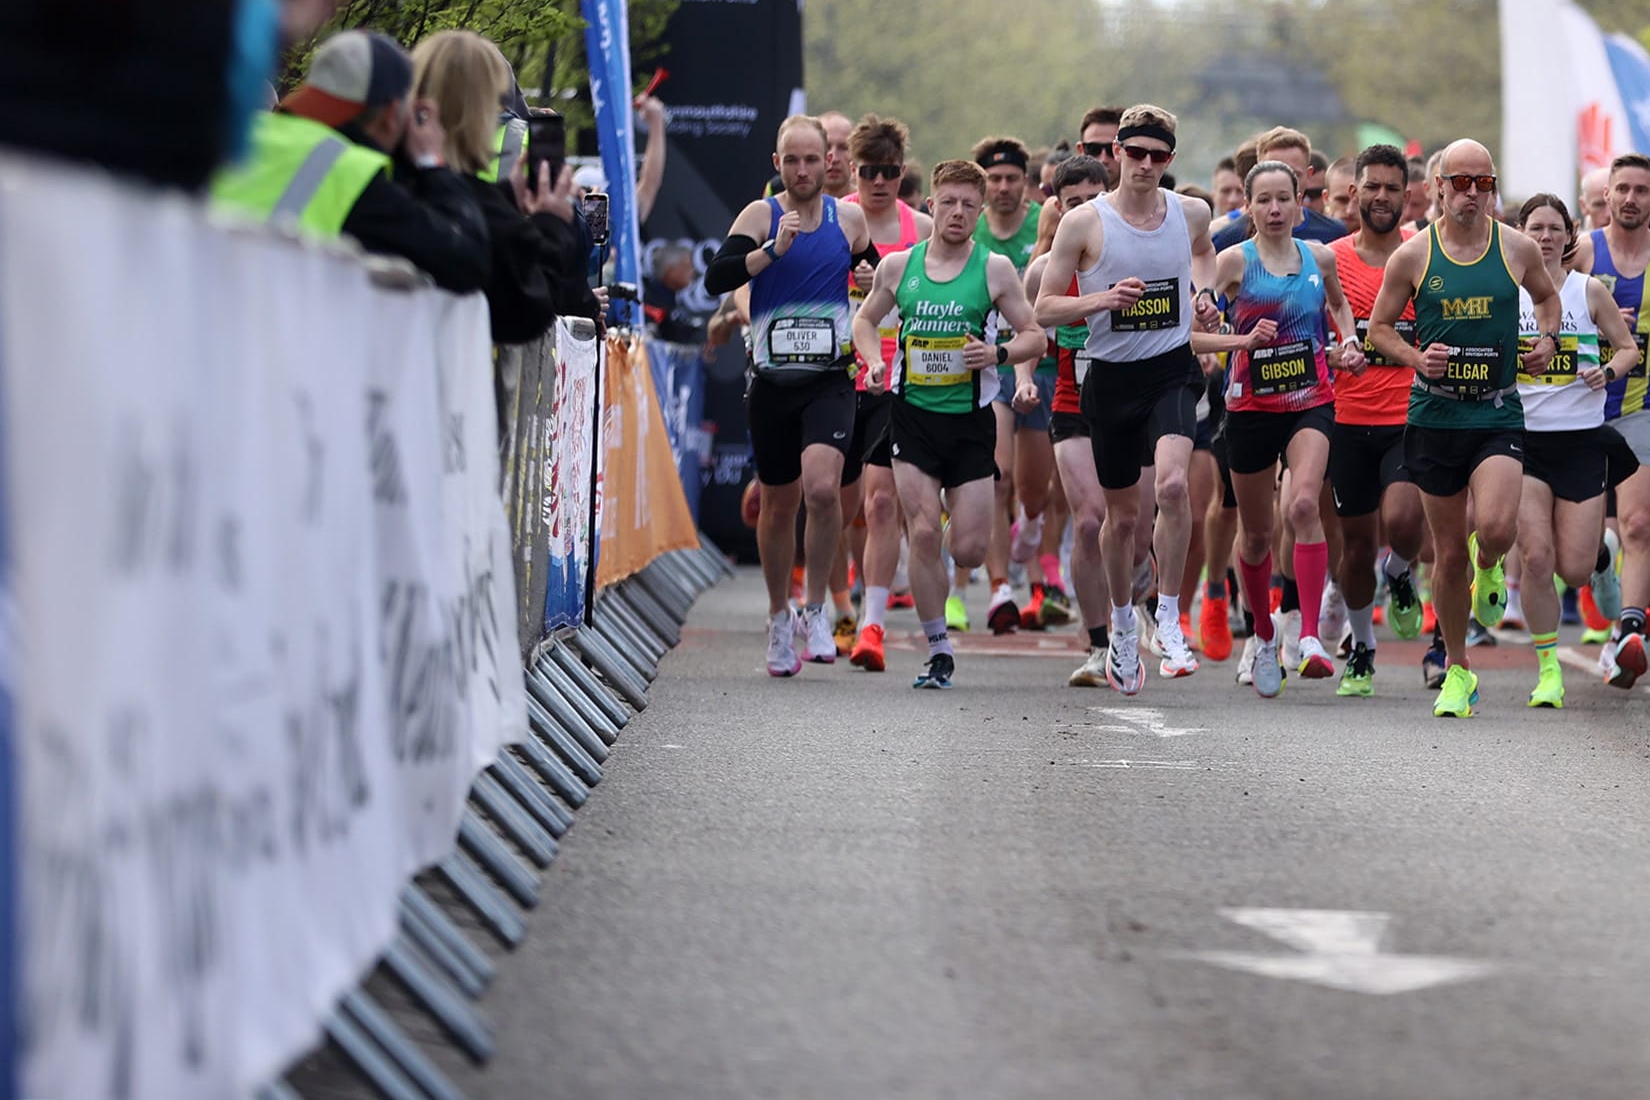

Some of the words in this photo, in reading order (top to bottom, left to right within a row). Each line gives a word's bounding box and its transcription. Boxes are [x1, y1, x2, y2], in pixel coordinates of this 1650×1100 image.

[916, 300, 964, 319] Hayle
[909, 317, 972, 332] Runners
[786, 331, 817, 340] OLIVER
[921, 352, 953, 362] DANIEL
[1447, 346, 1461, 356] BP
[926, 363, 949, 373] 6004
[1261, 357, 1305, 380] GIBSON
[1517, 353, 1571, 371] RRTS
[1448, 363, 1488, 380] ELGAR
